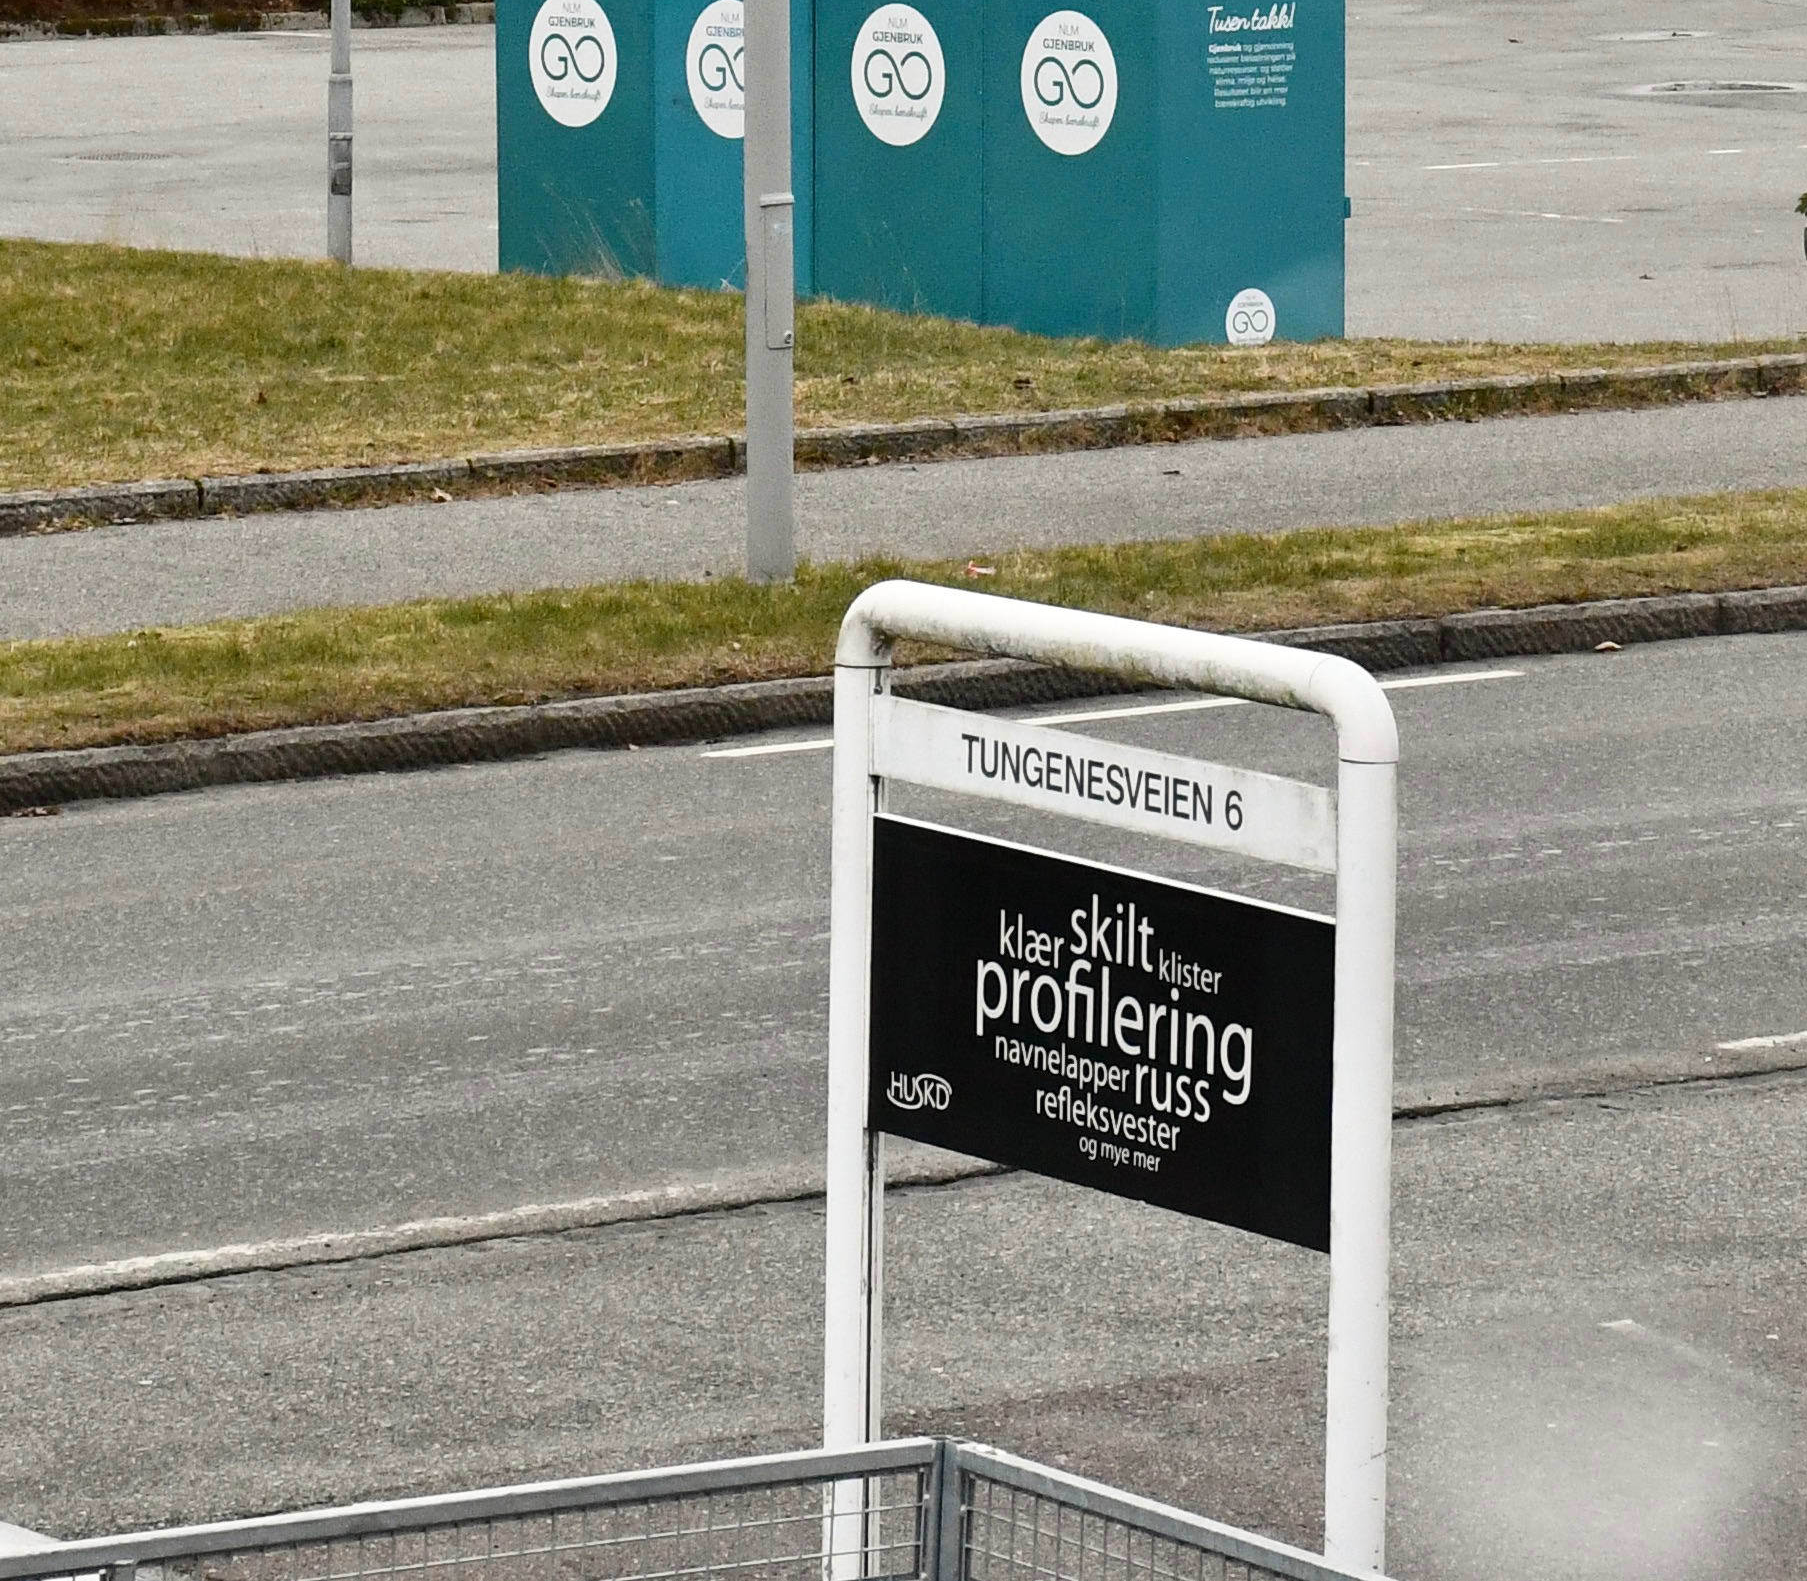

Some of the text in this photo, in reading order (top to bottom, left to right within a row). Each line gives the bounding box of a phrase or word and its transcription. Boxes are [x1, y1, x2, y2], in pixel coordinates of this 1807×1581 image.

[548, 16, 596, 28] GJENBRUK
[706, 26, 744, 37] GJENBR
[872, 31, 923, 44] GJENBRUK
[1207, 2, 1296, 34] Tusen takk!
[541, 33, 605, 83] GO
[1043, 38, 1095, 52] GJENBRUK
[864, 48, 932, 100] GO
[1034, 56, 1104, 109] GO
[1233, 310, 1268, 334] GO
[961, 733, 1243, 831] TUNGENESVEIEN 6
[999, 893, 1222, 994] klær skilt klister
[976, 958, 1253, 1105] profilering
[995, 1035, 1210, 1122] navnelapper russ
[1036, 1085, 1180, 1151] refleksvester
[1079, 1134, 1160, 1172] og mye mer
